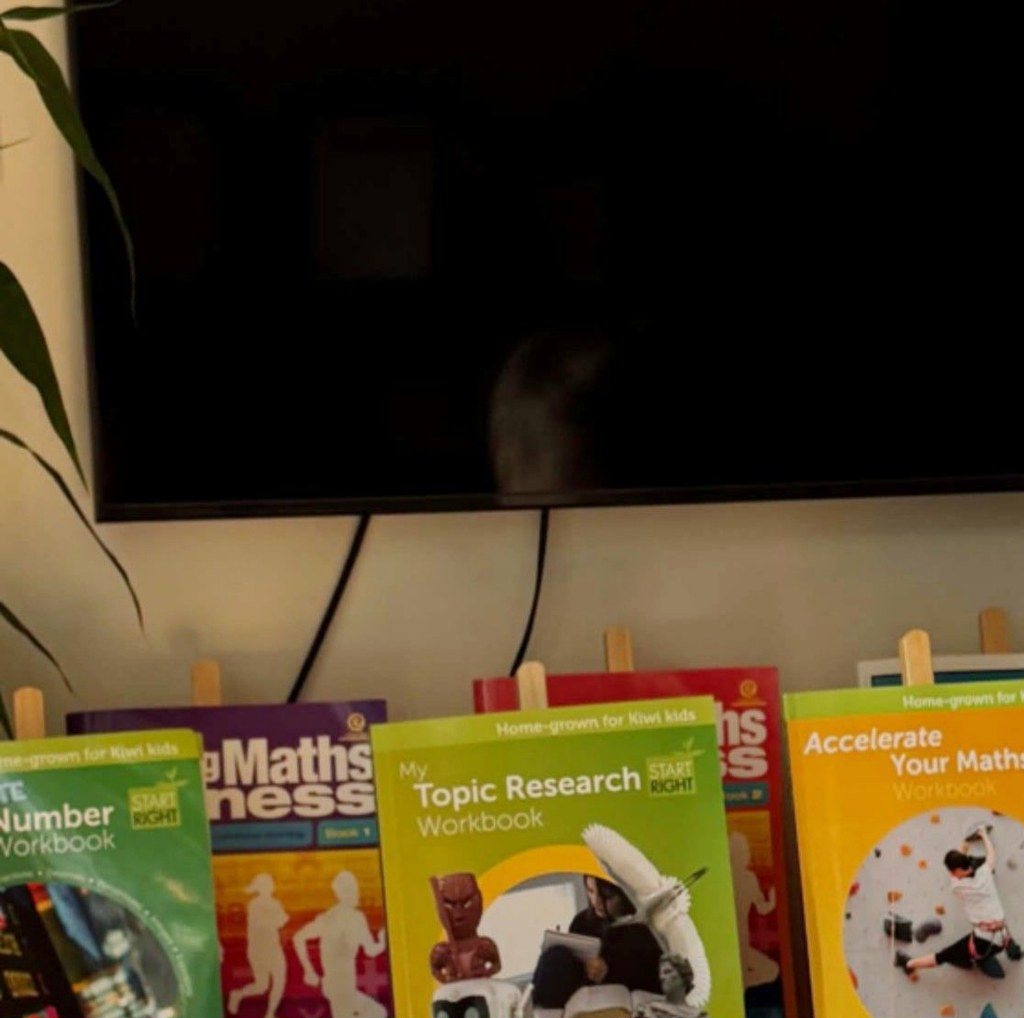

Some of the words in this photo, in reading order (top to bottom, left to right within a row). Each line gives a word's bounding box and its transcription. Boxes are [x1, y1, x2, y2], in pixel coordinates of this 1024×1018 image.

[902, 693, 994, 710] Home-grown
[997, 691, 1016, 705] for
[497, 716, 599, 738] Home-grown
[602, 713, 624, 728] for
[628, 711, 662, 727] Kiwi
[664, 709, 697, 723] kids
[803, 726, 943, 755] Accelerate
[84, 747, 107, 762] for
[110, 743, 144, 760] Kiwi
[147, 742, 180, 757] kids
[400, 761, 428, 781] My
[649, 760, 693, 779] START
[890, 753, 949, 777] Your
[413, 779, 498, 811] Topic
[506, 767, 642, 801] Research
[651, 777, 694, 794] RIGHT
[893, 778, 998, 801] Workbook
[131, 791, 178, 811] START
[133, 809, 178, 826] RIGHT
[417, 807, 544, 838] Workbook
